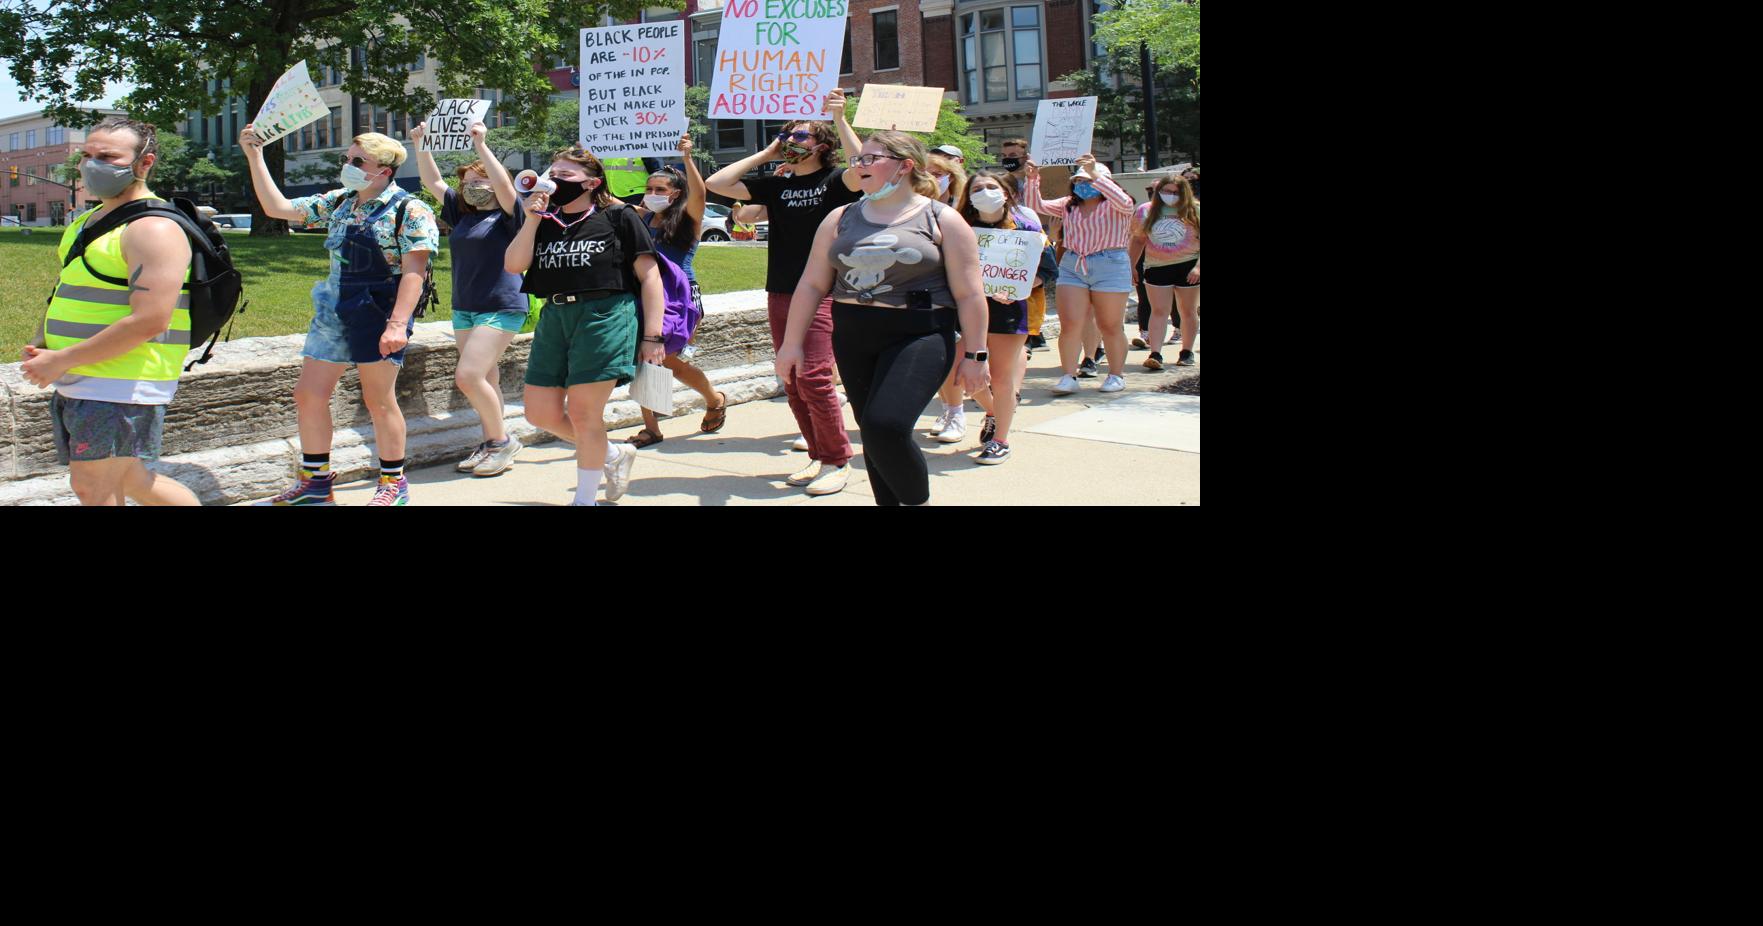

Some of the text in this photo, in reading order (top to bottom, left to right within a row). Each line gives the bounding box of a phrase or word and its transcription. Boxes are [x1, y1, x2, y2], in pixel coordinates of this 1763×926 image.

[725, 0, 846, 19] NO EXCUSES
[585, 25, 678, 48] BLACK PEOPLE
[756, 21, 800, 46] FOR
[590, 51, 617, 64] ARE
[719, 49, 826, 73] HUMAN
[588, 72, 602, 81] OF
[604, 70, 626, 79] THE
[631, 67, 645, 77] IN
[729, 72, 819, 94] RIGHTS
[588, 85, 662, 101] BUT BLACK
[587, 99, 676, 115] MEN MAKE UP
[430, 116, 469, 134] LIVES
[593, 111, 668, 129] OVER 30%
[255, 122, 286, 143] LACK
[585, 130, 680, 143] OF THE IN PRISON
[422, 134, 471, 151] MATTER
[590, 142, 648, 153] POPULATION
[569, 240, 606, 253] LIVES
[538, 253, 592, 269] MATTER
[980, 263, 1028, 282] RONGER
